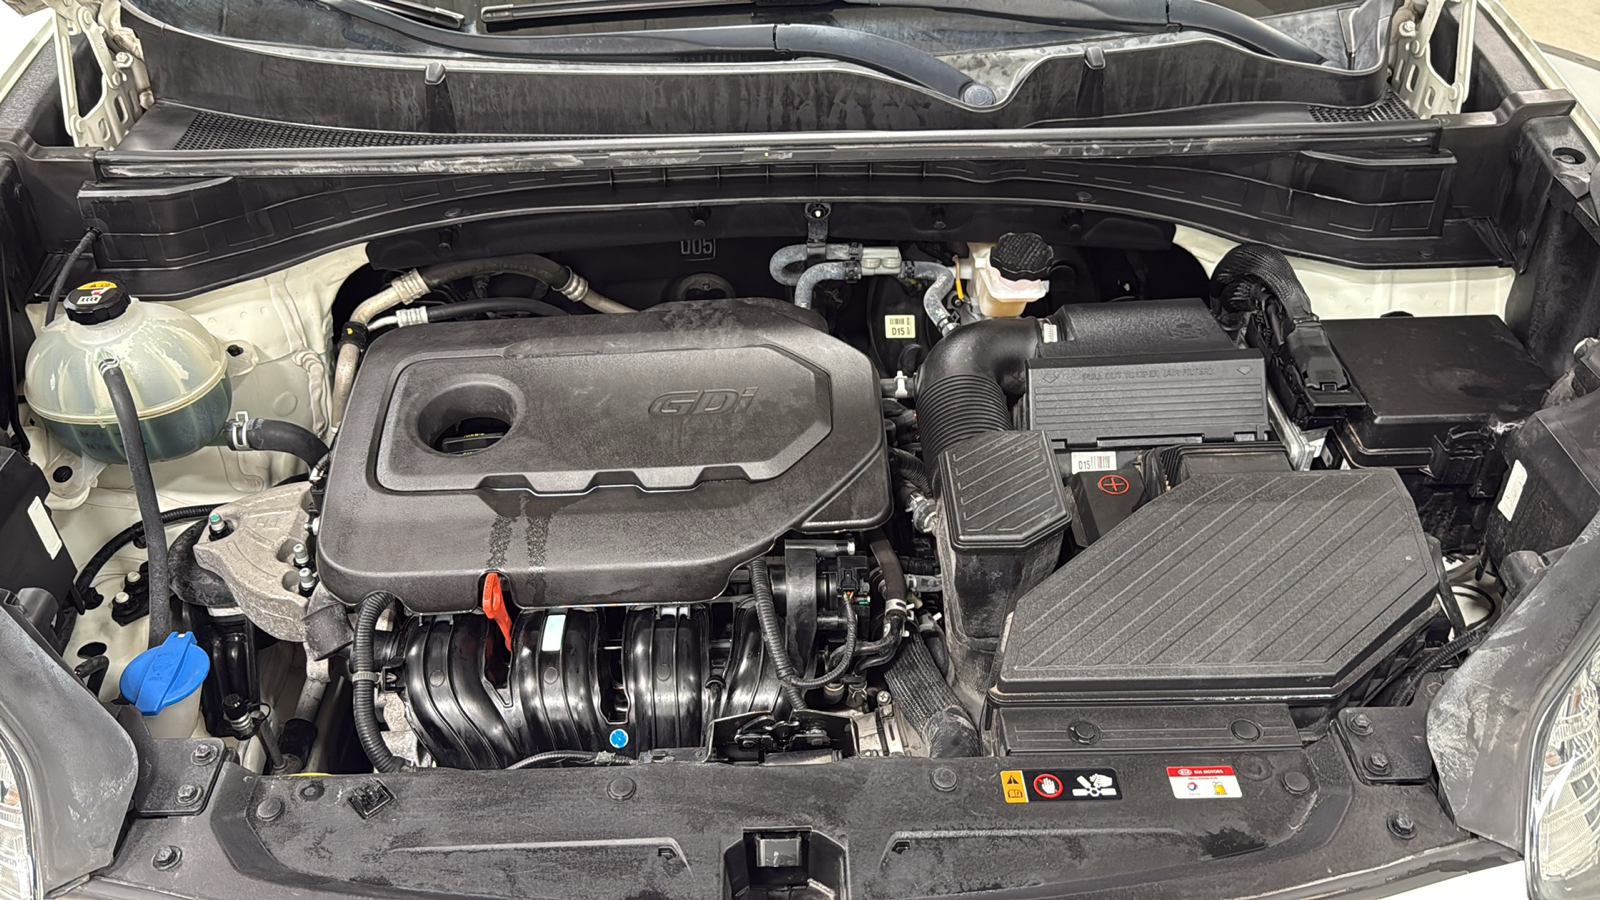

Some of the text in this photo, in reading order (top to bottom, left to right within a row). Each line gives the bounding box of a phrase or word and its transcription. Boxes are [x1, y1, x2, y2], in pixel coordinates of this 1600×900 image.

[891, 327, 905, 336] D15
[1105, 372, 1122, 380] OUT
[648, 387, 758, 415] GDi
